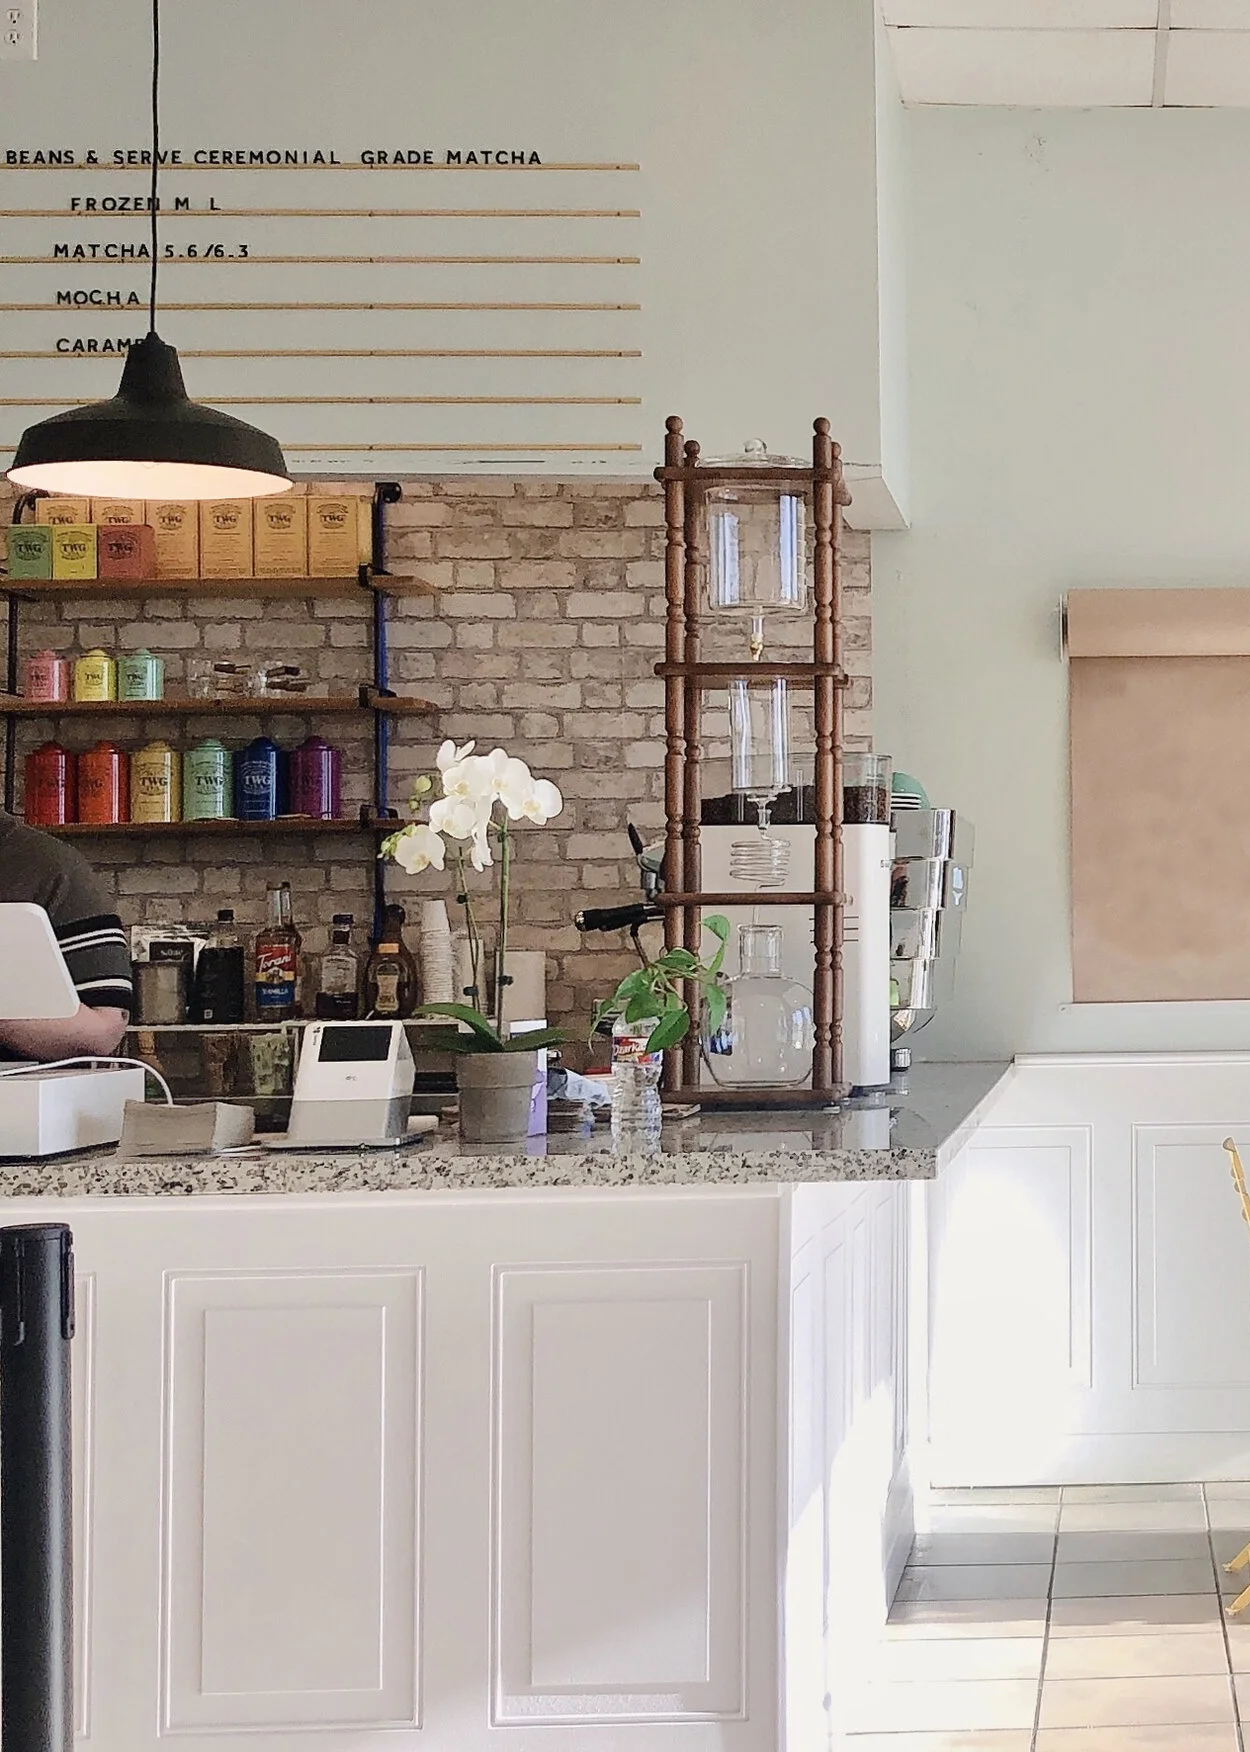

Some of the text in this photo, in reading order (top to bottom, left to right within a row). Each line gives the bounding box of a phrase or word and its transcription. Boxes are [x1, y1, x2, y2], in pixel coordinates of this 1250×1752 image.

[6, 150, 542, 165] BEANS & SERVE CEREMONIAL GRADE MATCHA
[71, 197, 221, 211] FROZEN M L
[54, 243, 150, 258] MATCHA
[57, 289, 140, 305] MOCHA
[56, 338, 147, 352] CARAM
[61, 543, 87, 552] TWG
[139, 777, 168, 787] TWG
[195, 775, 224, 786] TWG
[244, 775, 271, 786] TWG
[257, 951, 291, 973] Torani
